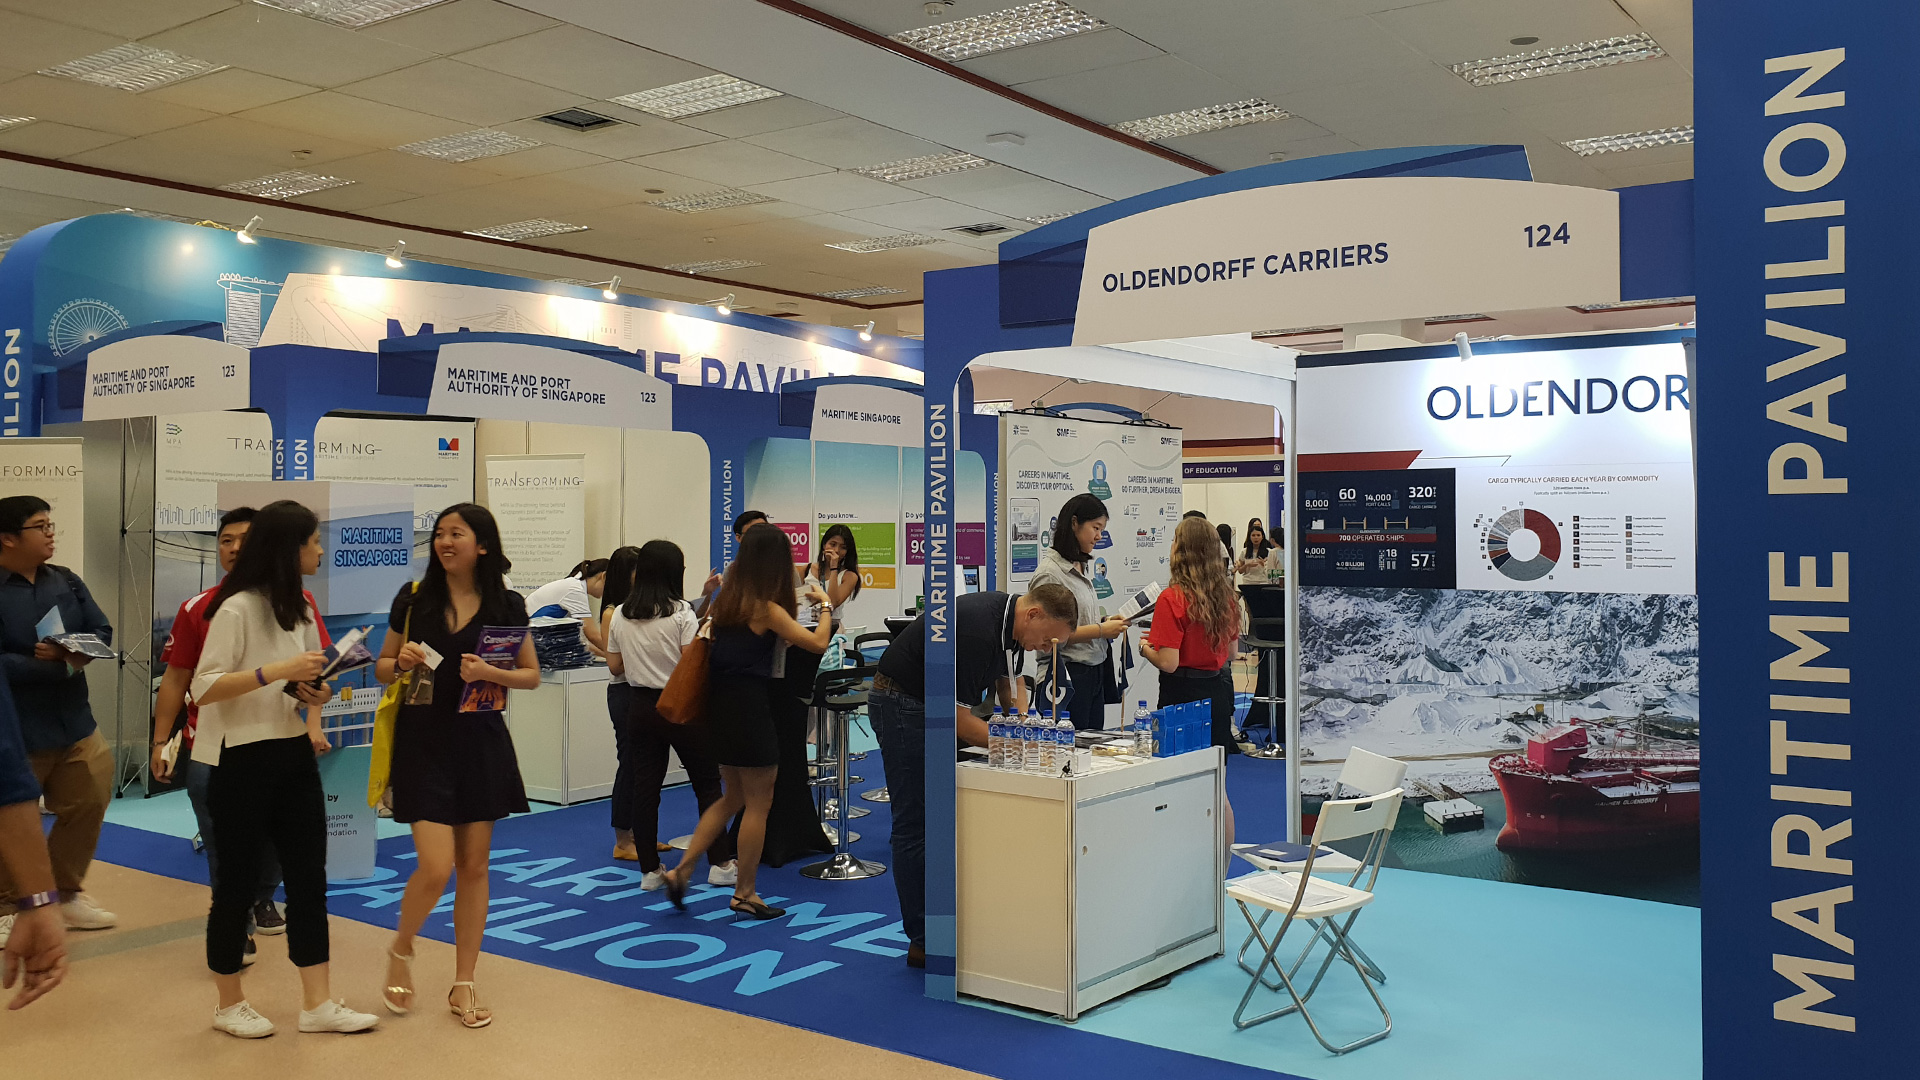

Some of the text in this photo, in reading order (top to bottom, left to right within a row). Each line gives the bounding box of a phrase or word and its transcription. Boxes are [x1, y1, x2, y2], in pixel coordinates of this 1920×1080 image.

[1102, 221, 1571, 293] OLDENDORFF CARRIERS 124
[93, 366, 170, 384] MARITIME AND PORT
[222, 365, 235, 377] 123
[447, 367, 571, 389] MARITIME AND PORT
[93, 376, 195, 397] AUTHORITY OF SINGAPORE
[447, 380, 606, 404] AUTHORITY OF SINGAPORE
[640, 392, 656, 403] 123
[1427, 374, 1690, 421] OLDENDOR
[821, 409, 901, 425] MARITIME SINGAPORE
[1018, 470, 1041, 479] CAREERS
[1041, 471, 1046, 479] IN
[1128, 475, 1147, 483] CAREERS
[1148, 476, 1153, 484] IN
[723, 460, 732, 521] PAVILION
[1016, 481, 1075, 491] DISCOVER YOUR OPTIONS.
[1128, 486, 1149, 495] FURTHER,
[1150, 486, 1164, 494] DREAM
[1164, 486, 1182, 495] BIGGER.
[1408, 486, 1433, 498] 320
[1338, 488, 1356, 500] 60
[1364, 493, 1391, 502] 14,000
[1305, 499, 1329, 508] 8,000
[930, 404, 947, 642] MARITIME PAVILION
[341, 527, 402, 544] MARITIME
[1764, 44, 1857, 1033] MARITIME PAVILION
[1304, 547, 1326, 555] 4,000
[1386, 549, 1397, 557] 18
[335, 549, 408, 567] SINGAPORE
[1411, 554, 1430, 567] 57
[327, 794, 339, 803] by
